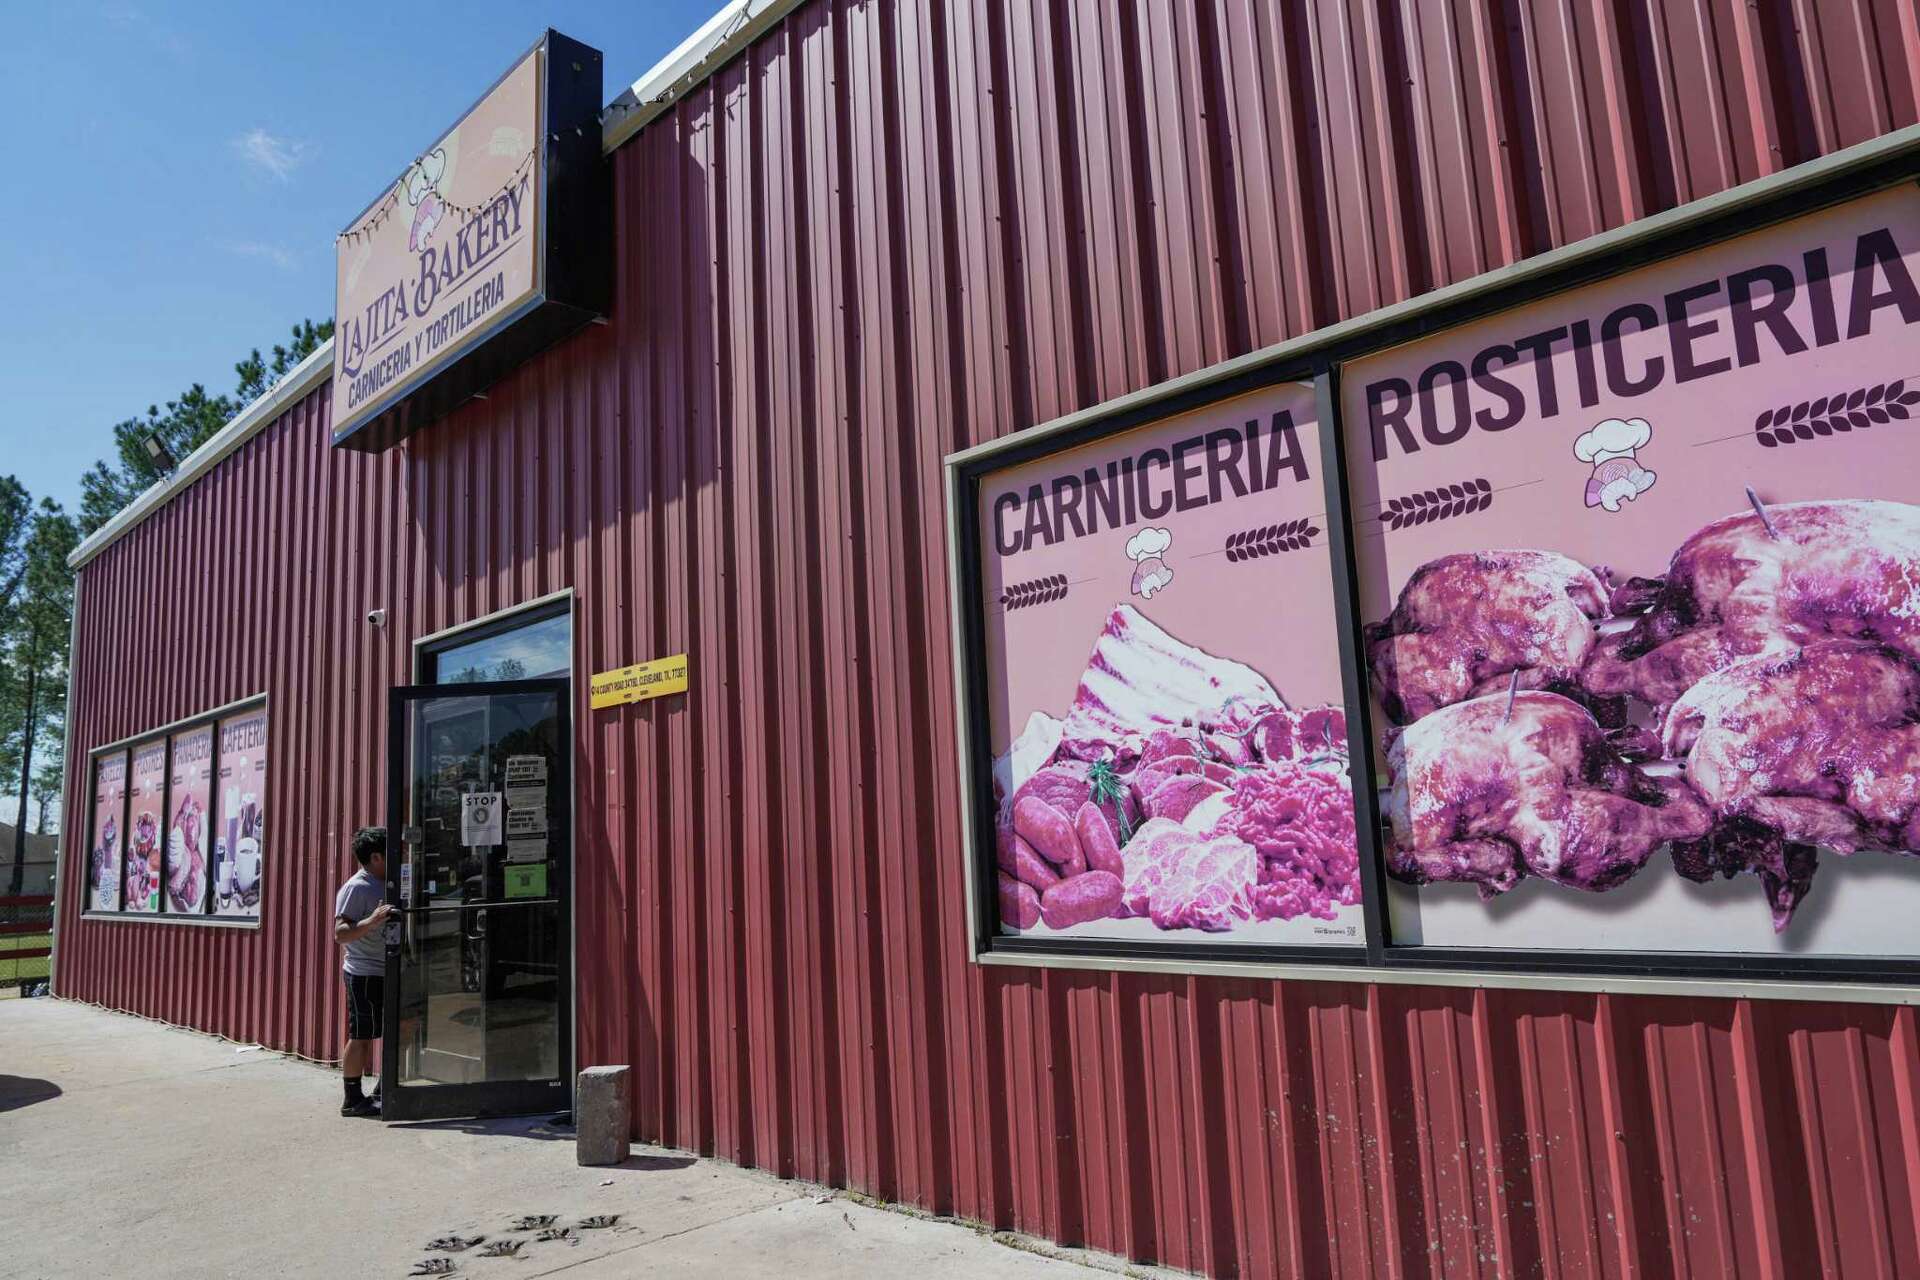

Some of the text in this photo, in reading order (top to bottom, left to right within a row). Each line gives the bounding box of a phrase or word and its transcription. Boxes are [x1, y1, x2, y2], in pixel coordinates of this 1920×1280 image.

[414, 179, 530, 317] BAKERY
[348, 272, 504, 408] CARNICERIA Y TORTILLERIA
[1366, 227, 1920, 461] ROSTICERIA
[993, 409, 1310, 557] CARNICERIA
[466, 796, 497, 806] STOP
